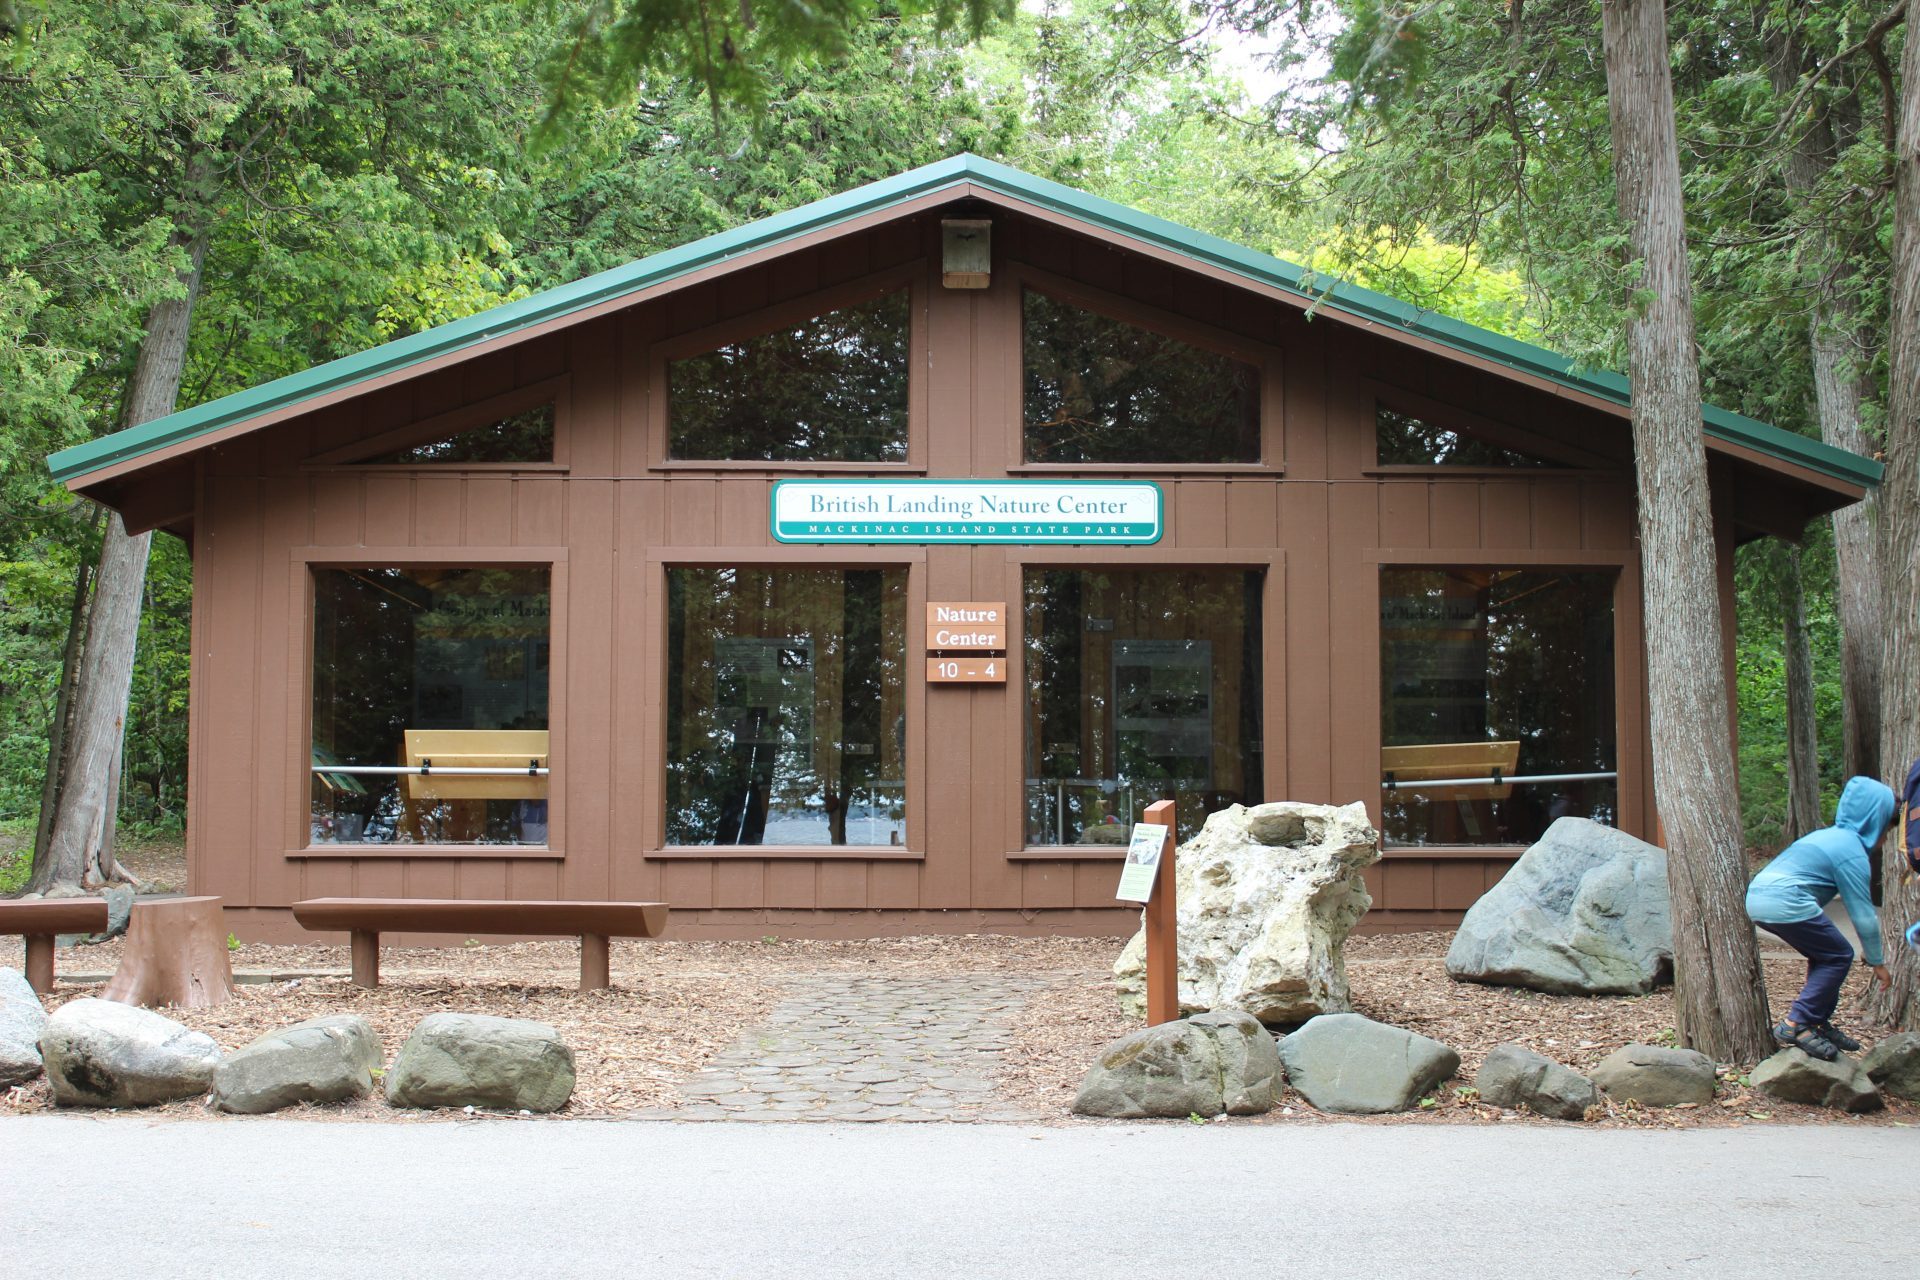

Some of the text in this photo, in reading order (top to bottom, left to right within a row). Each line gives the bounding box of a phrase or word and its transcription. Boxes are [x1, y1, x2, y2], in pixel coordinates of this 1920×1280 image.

[809, 494, 1128, 519] British Landing Nature Center
[809, 525, 1131, 534] MACKINAC ISLAND STATE PARK
[510, 600, 550, 616] Mack
[937, 607, 997, 622] Nature
[936, 630, 997, 646] Center
[938, 662, 958, 678] 10
[985, 662, 995, 678] 4
